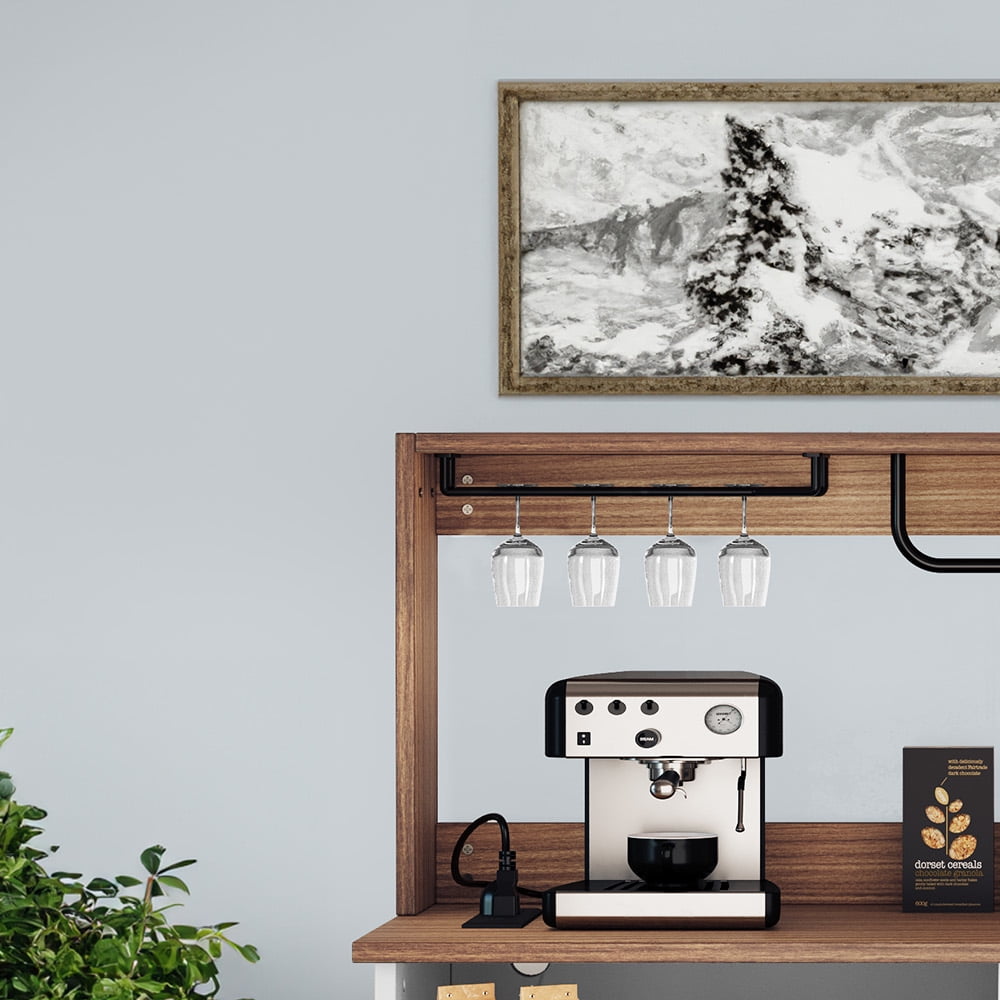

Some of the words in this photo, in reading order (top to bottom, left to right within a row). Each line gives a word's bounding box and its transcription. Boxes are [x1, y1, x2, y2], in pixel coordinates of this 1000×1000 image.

[914, 859, 945, 869] dorset
[947, 859, 982, 869] cereals
[914, 869, 951, 877] chocolate
